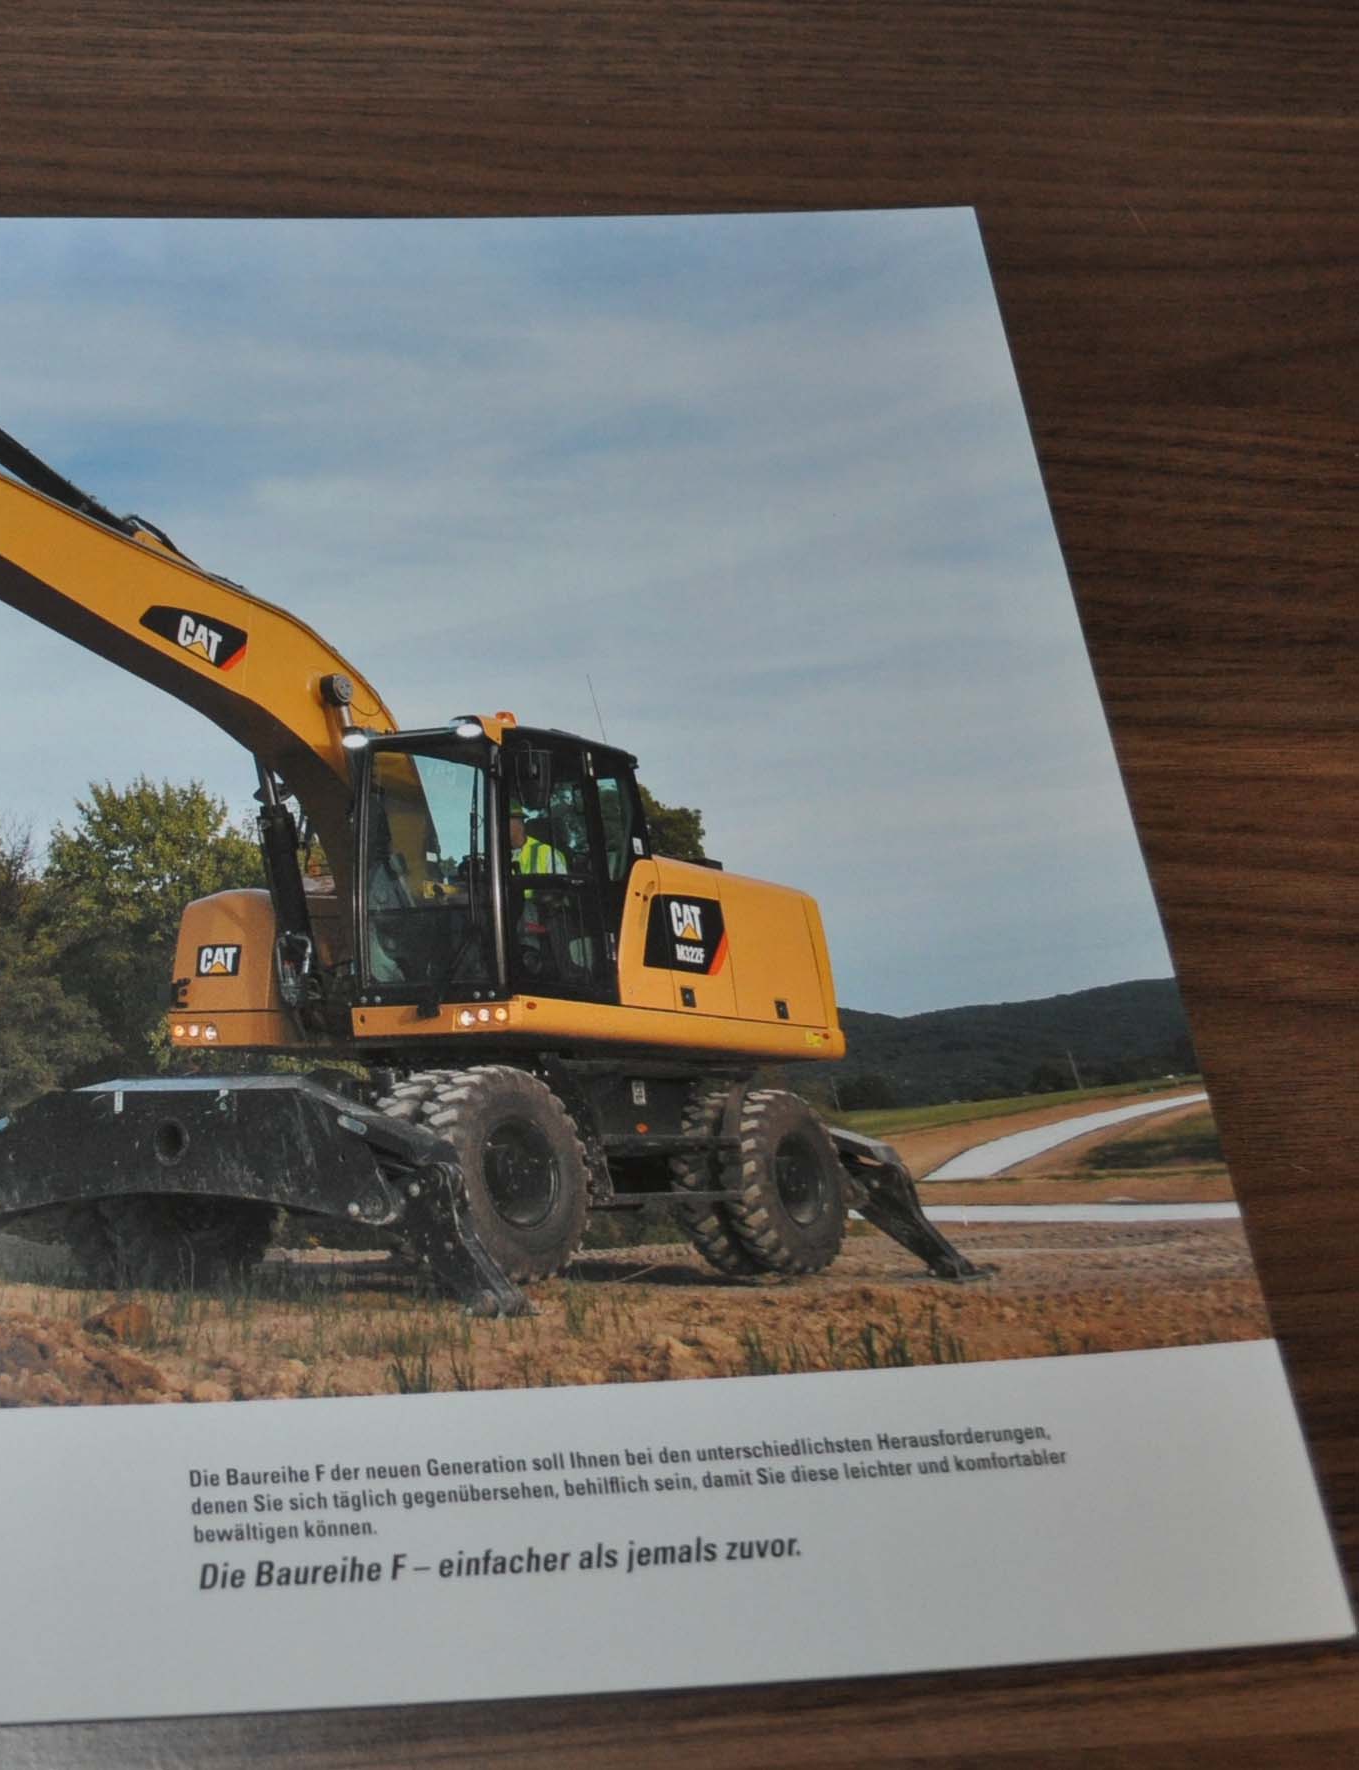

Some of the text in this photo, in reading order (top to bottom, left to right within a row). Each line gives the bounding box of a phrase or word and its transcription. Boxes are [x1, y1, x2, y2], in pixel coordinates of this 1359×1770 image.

[177, 614, 222, 663] CAT
[670, 901, 703, 940] CAT
[200, 947, 237, 974] CAT
[189, 1427, 1051, 1488] Die Baureihe F der neuen Generation soll Ihnen bei den unterschiedlichsten Herausforderungen,
[191, 1449, 1065, 1515] denen Sie sich täglich gegenübersehen, behilflich sein, damit Sie diese leichter und komfortabler
[193, 1520, 377, 1544] bewältigen können.
[199, 1562, 246, 1590] Die
[255, 1556, 382, 1587] Baureihe
[391, 1554, 407, 1580] F
[439, 1547, 571, 1578] einfacher
[579, 1542, 618, 1570] als
[627, 1536, 717, 1573] jemals
[725, 1538, 801, 1560] zuvor.
